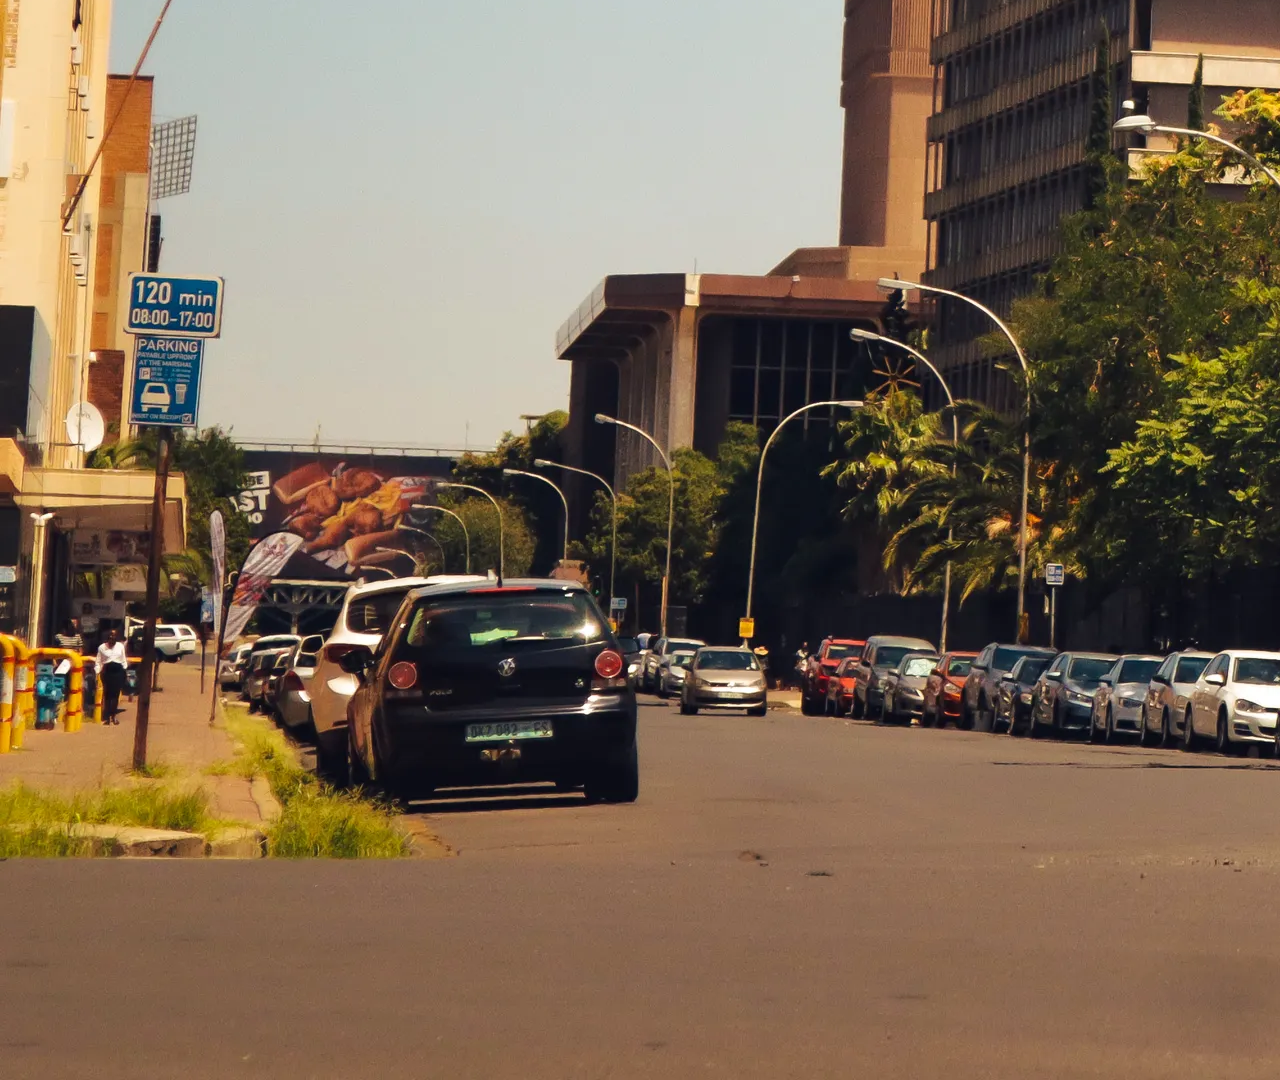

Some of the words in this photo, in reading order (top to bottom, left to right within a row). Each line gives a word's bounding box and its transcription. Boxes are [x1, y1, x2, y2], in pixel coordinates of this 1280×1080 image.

[136, 280, 172, 305] 120
[179, 290, 213, 307] min
[138, 339, 198, 353] PARKING
[137, 352, 166, 360] PAYABLE
[167, 353, 198, 361] UPFRONT
